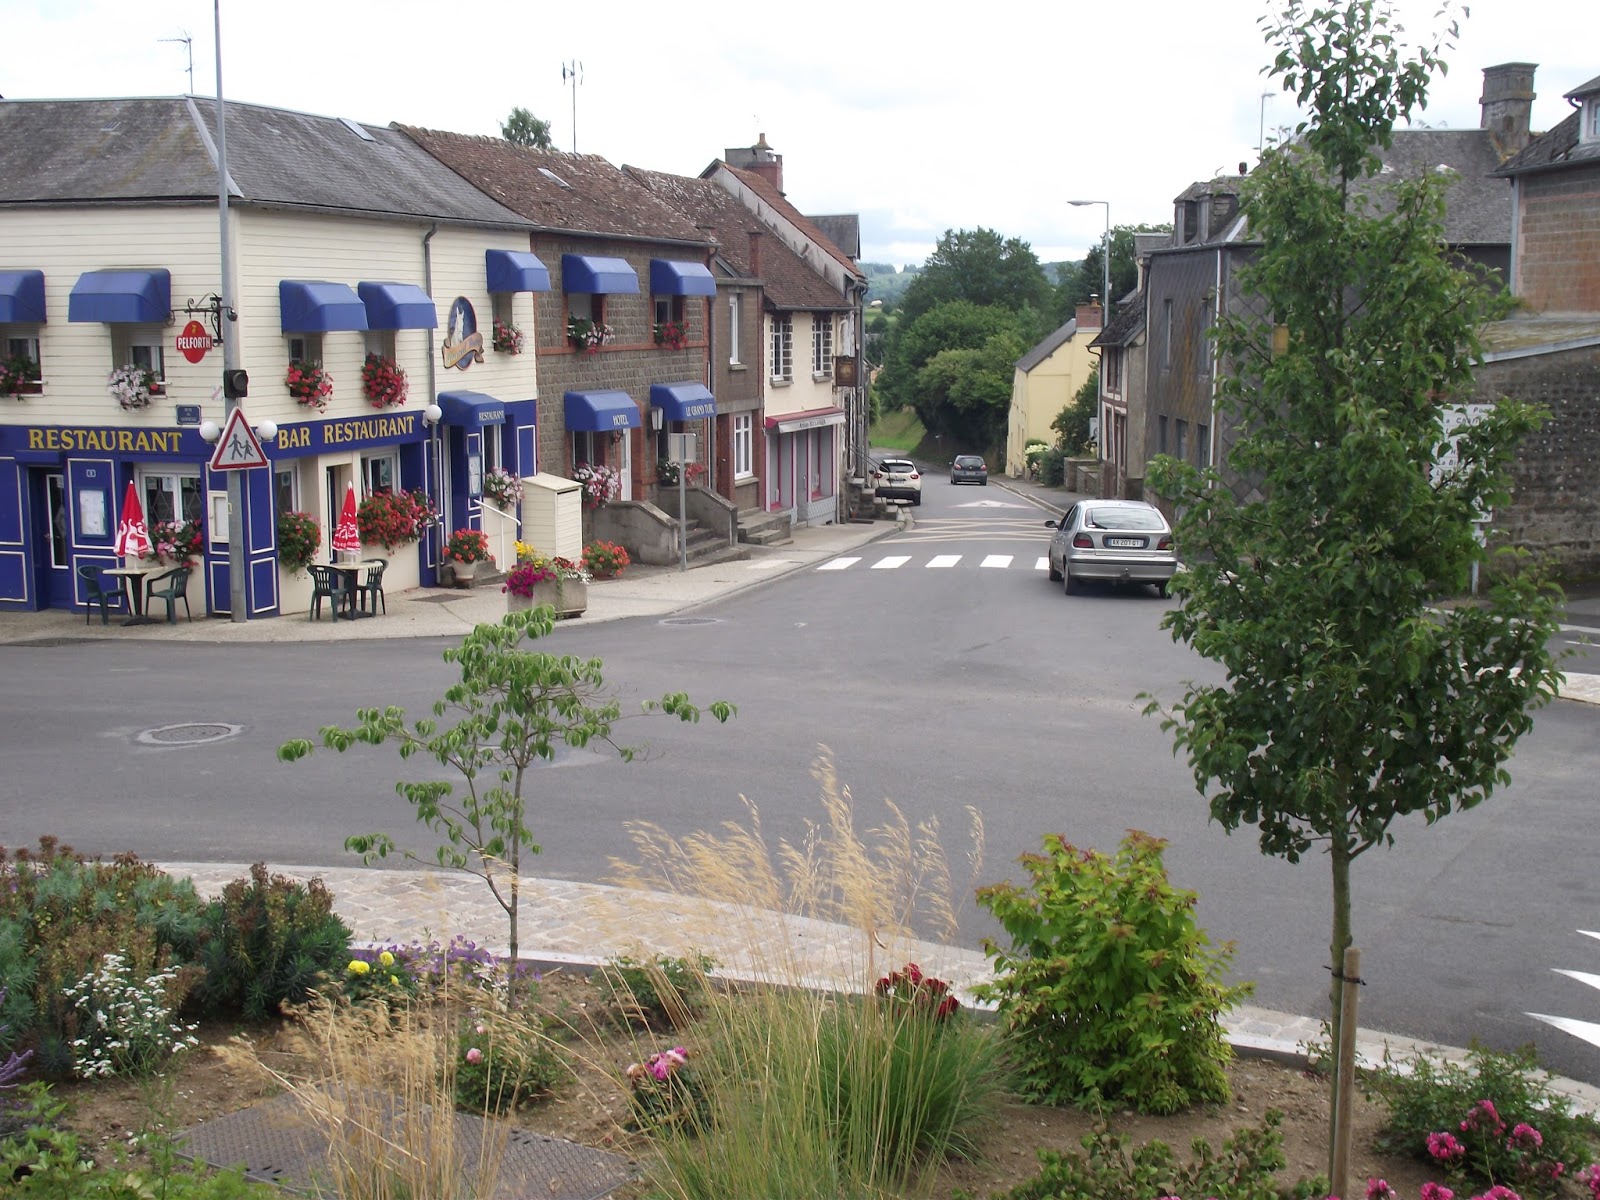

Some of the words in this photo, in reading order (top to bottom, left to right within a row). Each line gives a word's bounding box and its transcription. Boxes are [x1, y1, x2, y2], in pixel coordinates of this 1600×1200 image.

[177, 337, 211, 350] PELFORTH
[478, 410, 505, 421] RESTAURANT
[28, 429, 183, 452] RESTAURANT
[278, 427, 311, 450] BAR
[323, 415, 415, 444] RESTAURANT
